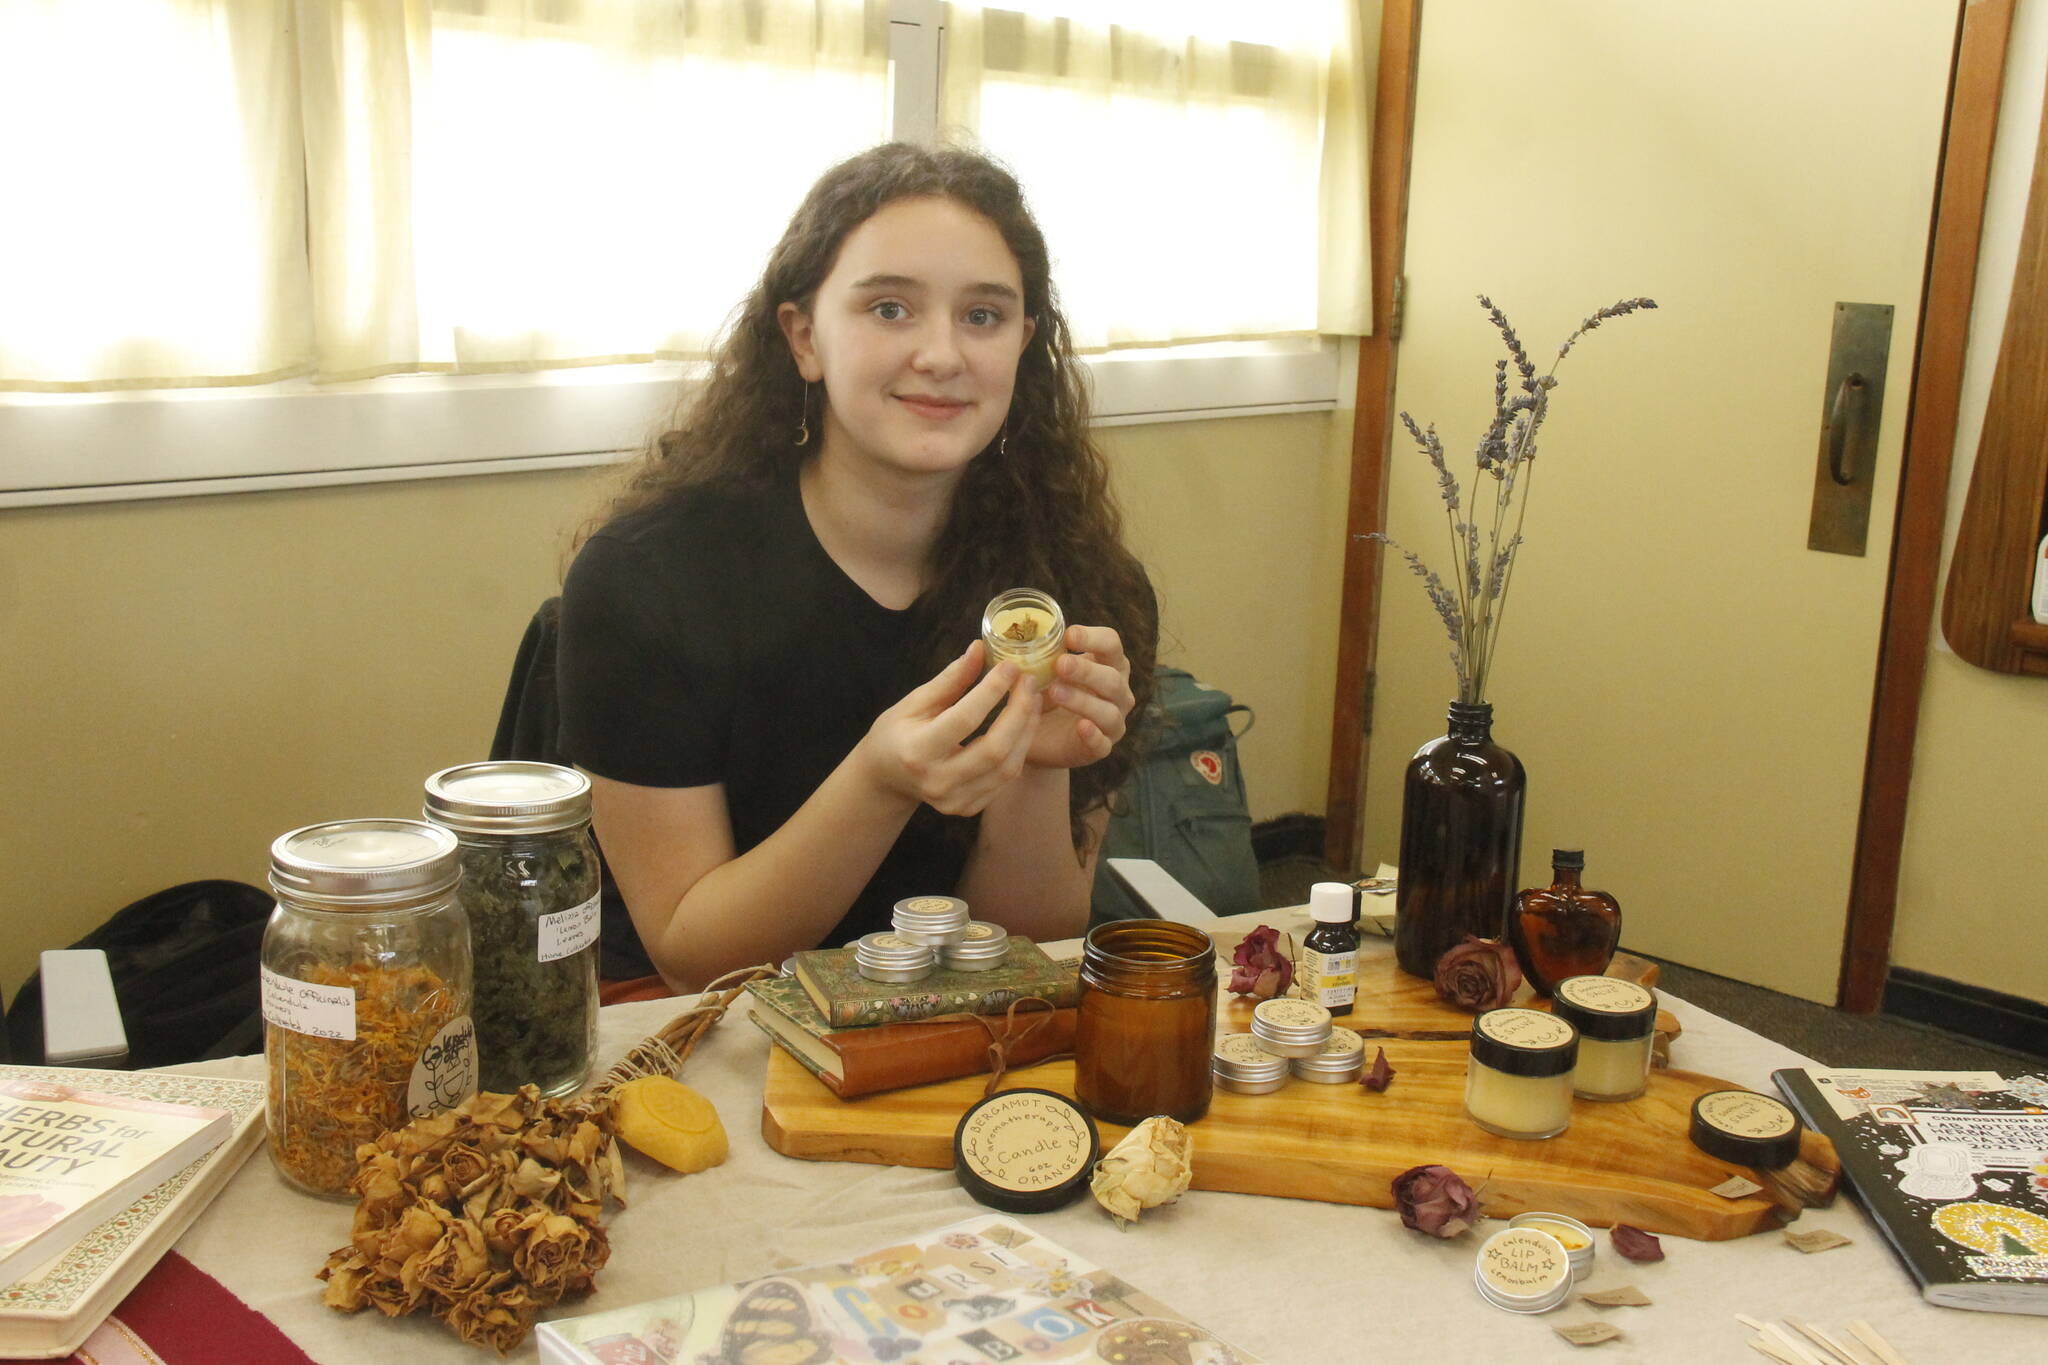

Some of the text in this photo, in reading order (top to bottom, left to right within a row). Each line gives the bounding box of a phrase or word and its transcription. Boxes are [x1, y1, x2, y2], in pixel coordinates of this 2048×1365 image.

[311, 1026, 345, 1039] 2022
[0, 1103, 152, 1140] HERBS for
[970, 1099, 1042, 1134] BERGAMOT
[1729, 1106, 1761, 1124] SALVE
[1931, 1115, 2029, 1123] COMPOSITION
[987, 1113, 1061, 1153] aromatherapy
[1927, 1121, 1964, 1130] LAB
[1968, 1123, 2017, 1131] NOTE
[1930, 1128, 1999, 1137] HERBAL
[0, 1124, 127, 1159] TURAL
[1937, 1135, 1994, 1144] ALICIA
[1968, 1143, 2048, 1151] 2023-2
[997, 1138, 1062, 1165] Candle
[1018, 1154, 1078, 1185] ORANGE
[1502, 1236, 1552, 1256] calendula
[1511, 1248, 1536, 1259] LIP
[1500, 1257, 1538, 1273] BALM
